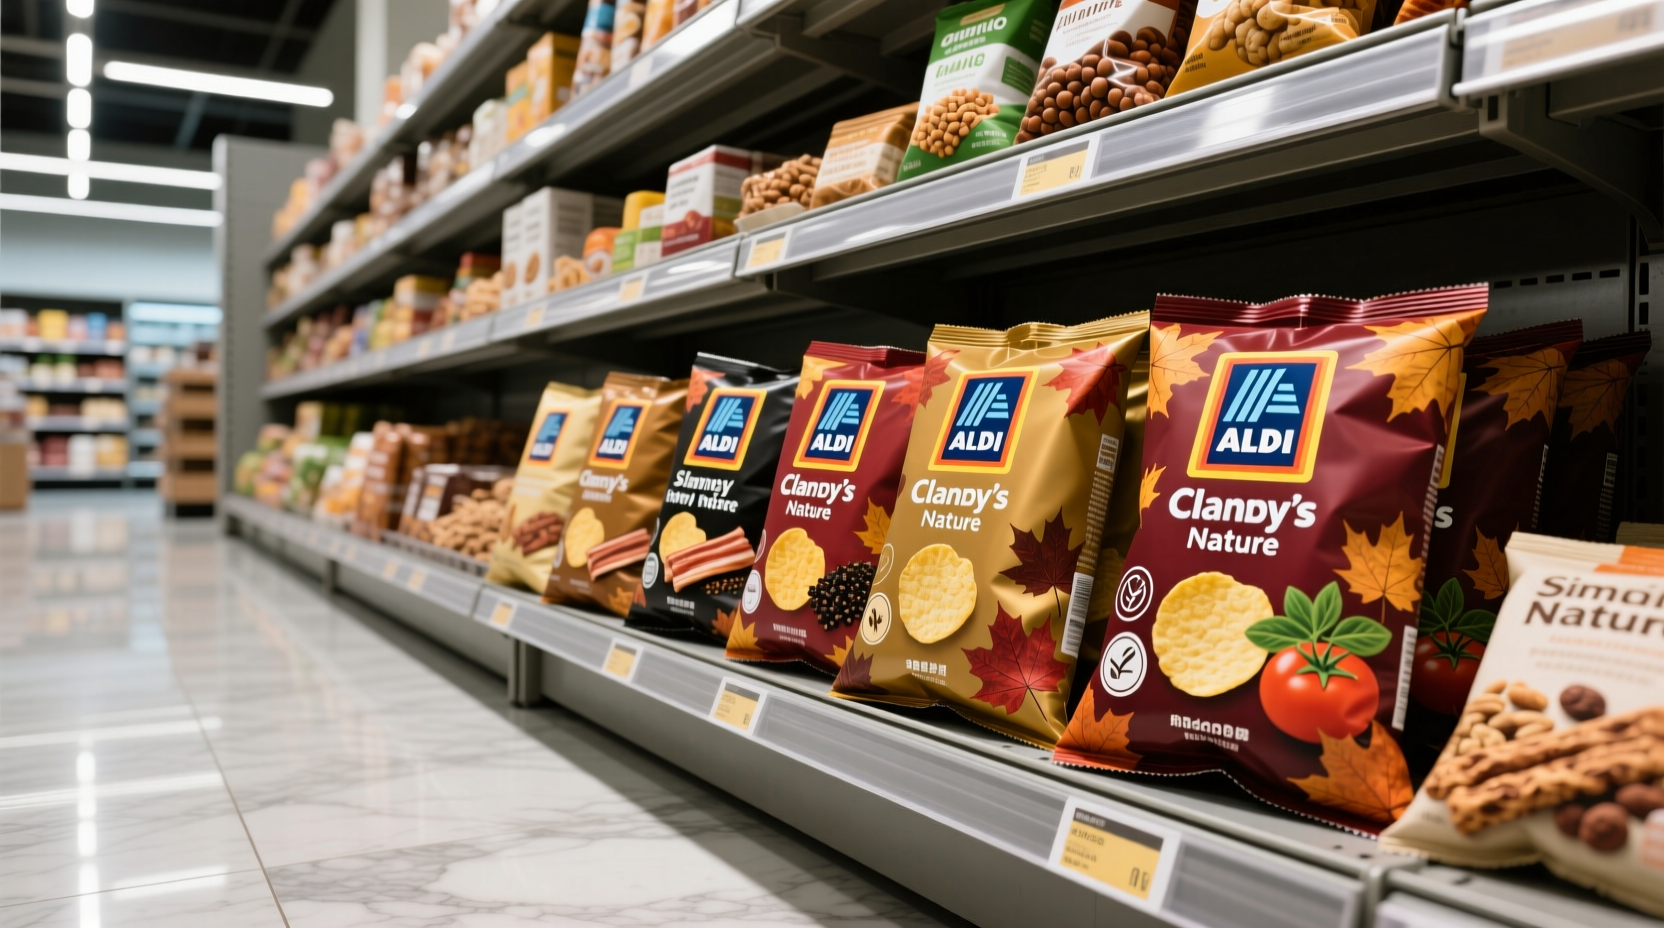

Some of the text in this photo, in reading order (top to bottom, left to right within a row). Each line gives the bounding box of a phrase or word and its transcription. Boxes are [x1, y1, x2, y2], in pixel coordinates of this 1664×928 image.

[698, 434, 739, 453] ALDI
[810, 433, 854, 453] ALDI
[948, 430, 1003, 452] ALDI
[1215, 427, 1295, 454] ALDI
[785, 499, 832, 520] Nature
[920, 509, 981, 532] Nature
[1186, 526, 1279, 556] Nature
[1524, 601, 1664, 638] Natur
